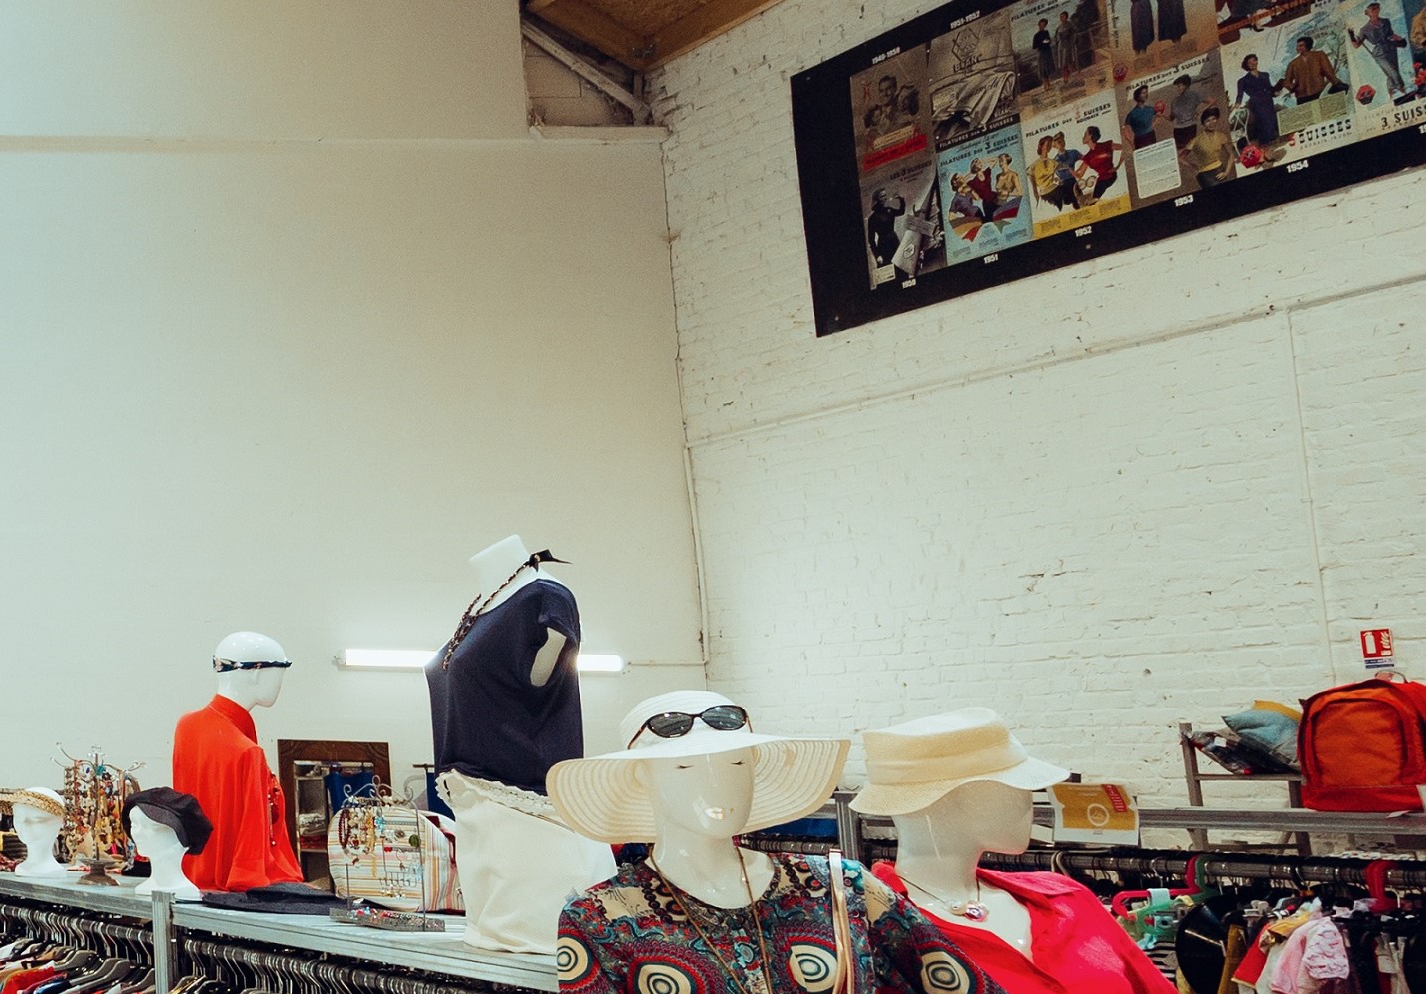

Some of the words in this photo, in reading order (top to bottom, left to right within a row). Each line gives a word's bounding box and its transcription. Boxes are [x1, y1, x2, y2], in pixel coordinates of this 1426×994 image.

[1026, 121, 1060, 138] FILATURES
[1083, 102, 1111, 117] SUISSES
[1381, 116, 1388, 128] 3
[1299, 118, 1352, 144] SUISSES
[940, 151, 971, 167] FILATURES
[1287, 160, 1309, 174] 1954
[1174, 194, 1194, 207] 1953
[1075, 226, 1092, 238] 1952
[983, 253, 999, 265] 1951
[901, 278, 918, 290] 1950
